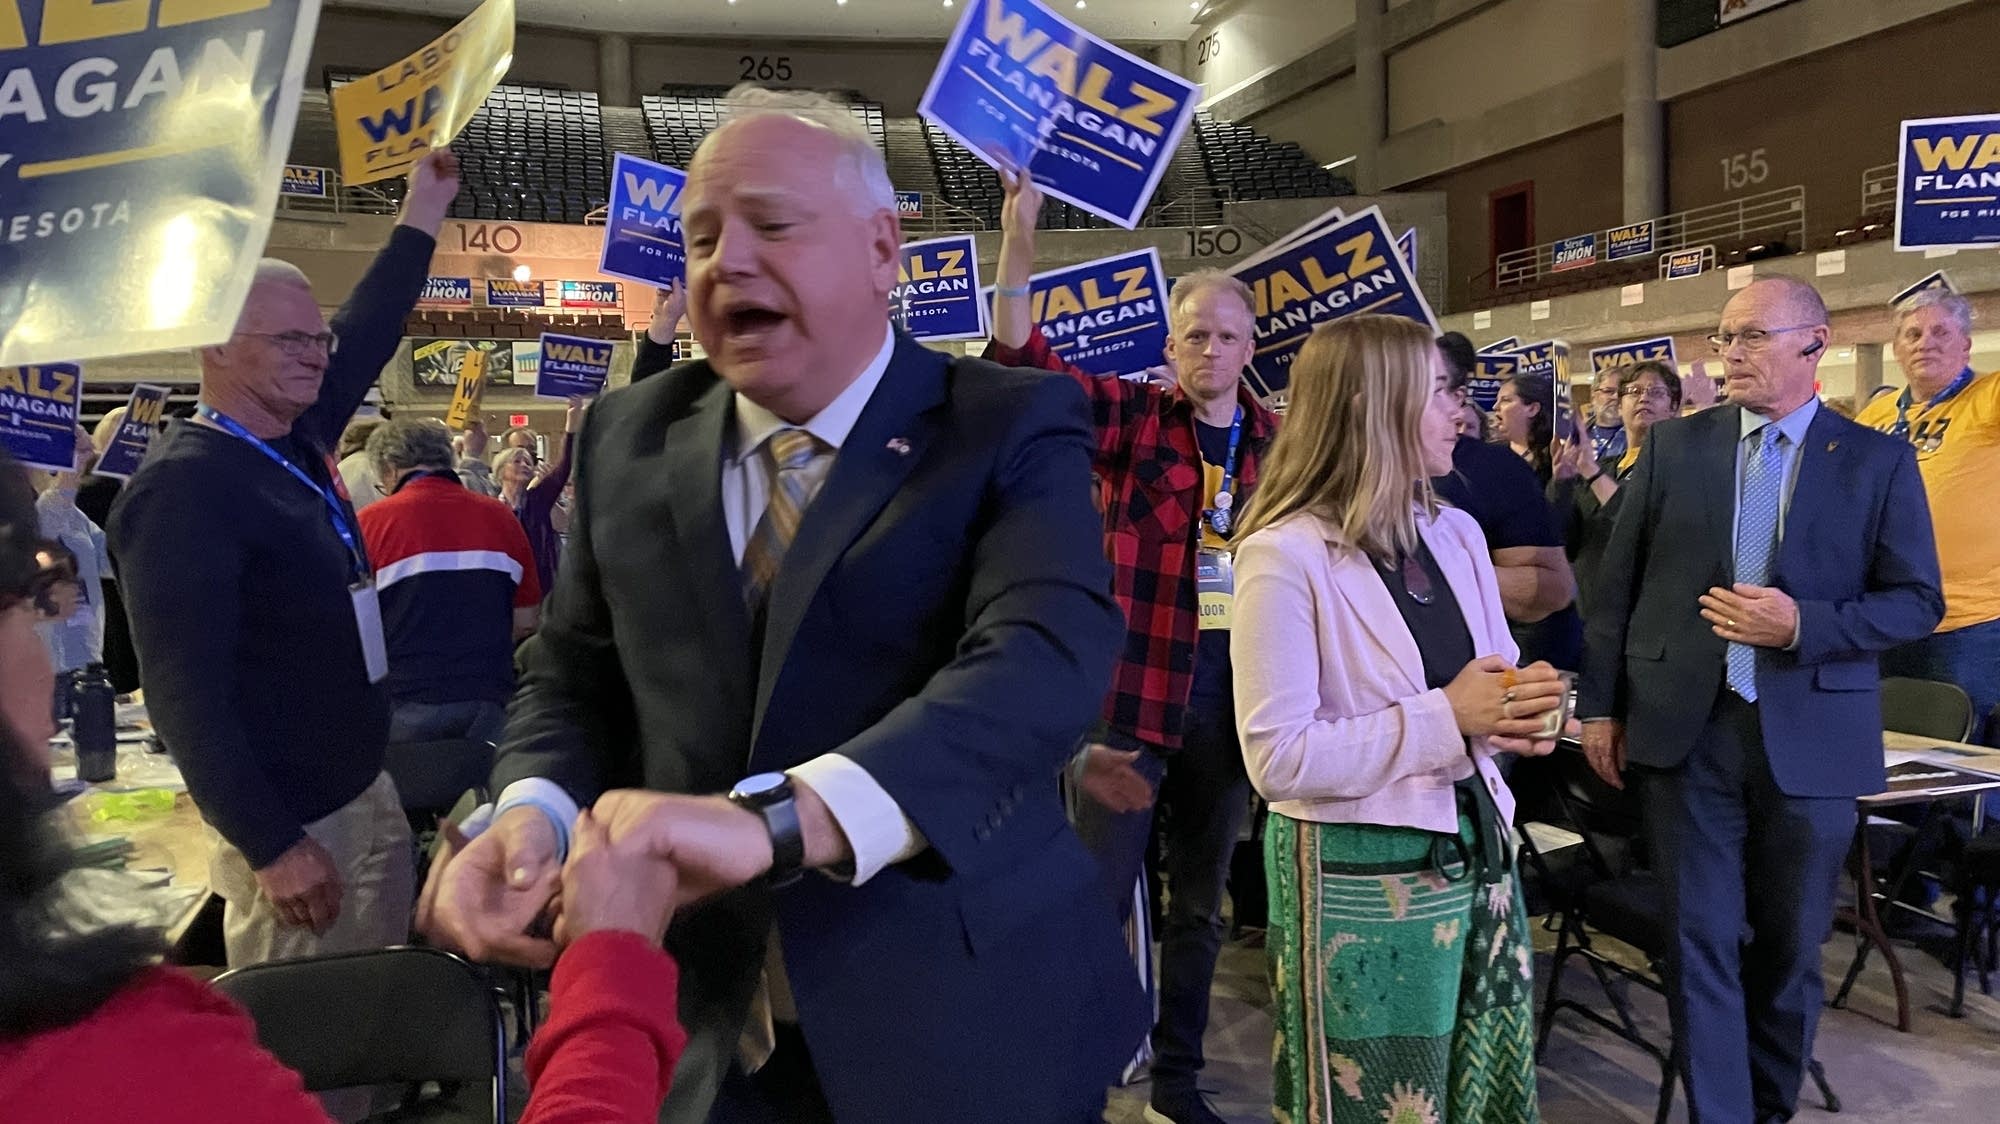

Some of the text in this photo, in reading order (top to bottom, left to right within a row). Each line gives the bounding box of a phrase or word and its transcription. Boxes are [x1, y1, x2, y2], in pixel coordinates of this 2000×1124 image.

[1198, 31, 1220, 66] 275
[739, 55, 792, 81] 265
[983, 0, 1177, 137] WALZ
[967, 37, 1158, 158] FLANAGAN
[1721, 148, 1769, 191] 155
[0, 200, 130, 242] ESOTA
[1940, 210, 1970, 219] FOR
[457, 224, 522, 254] 140
[1187, 229, 1242, 257] 150
[1611, 223, 1650, 242] WALZ
[640, 245, 662, 257] FOR
[1555, 245, 1593, 264] SIMON
[545, 342, 610, 366] WALZ
